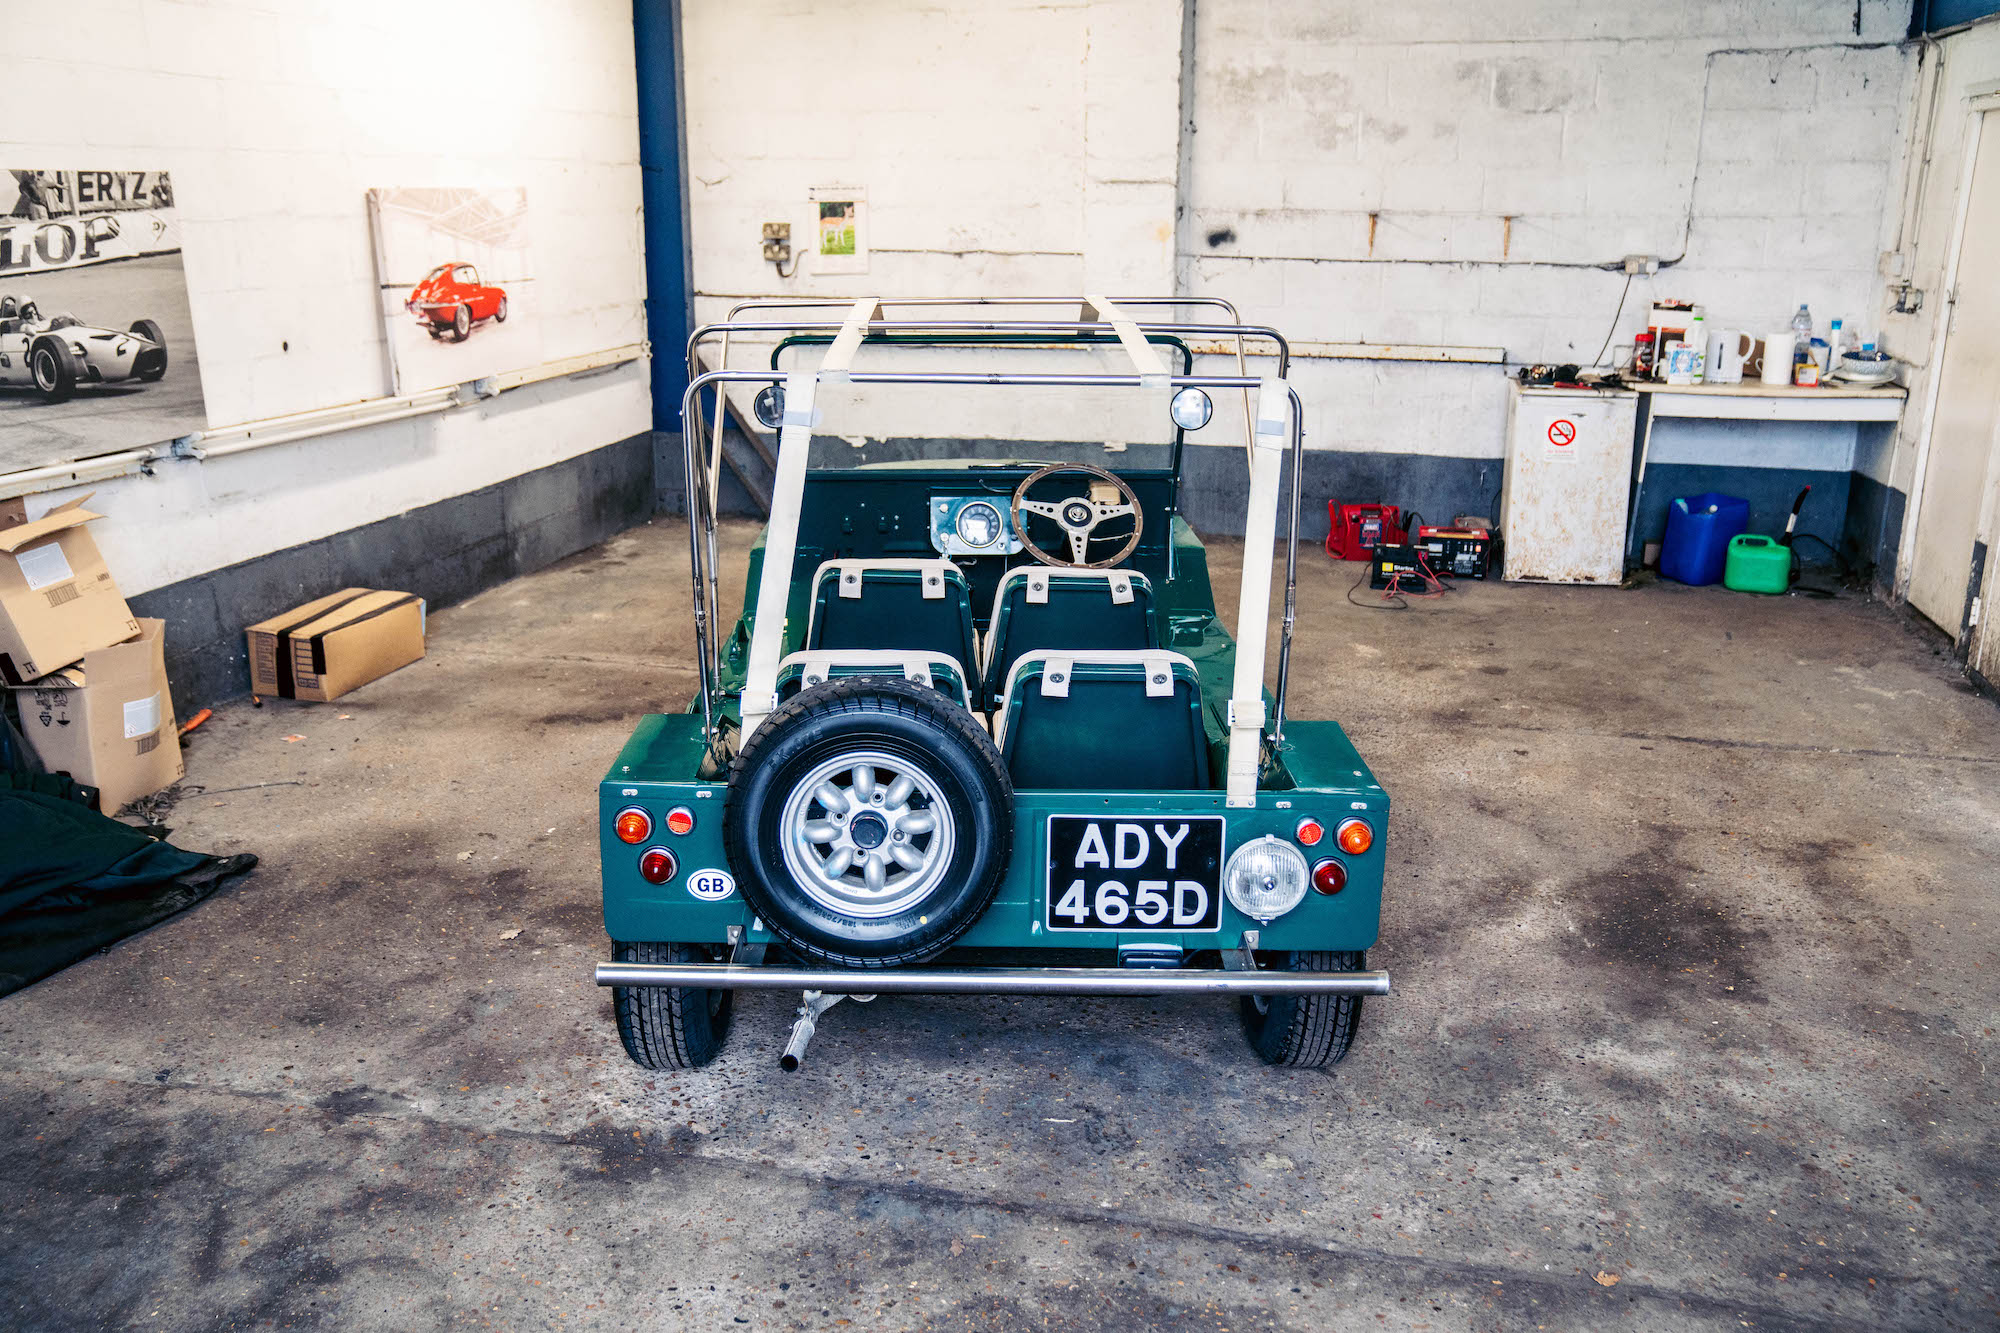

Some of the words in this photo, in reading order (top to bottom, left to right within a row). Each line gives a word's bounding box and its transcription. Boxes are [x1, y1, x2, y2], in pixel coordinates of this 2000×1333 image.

[1075, 823, 1190, 869] ADY
[697, 878, 724, 892] GB
[1055, 879, 1208, 925] 465D
